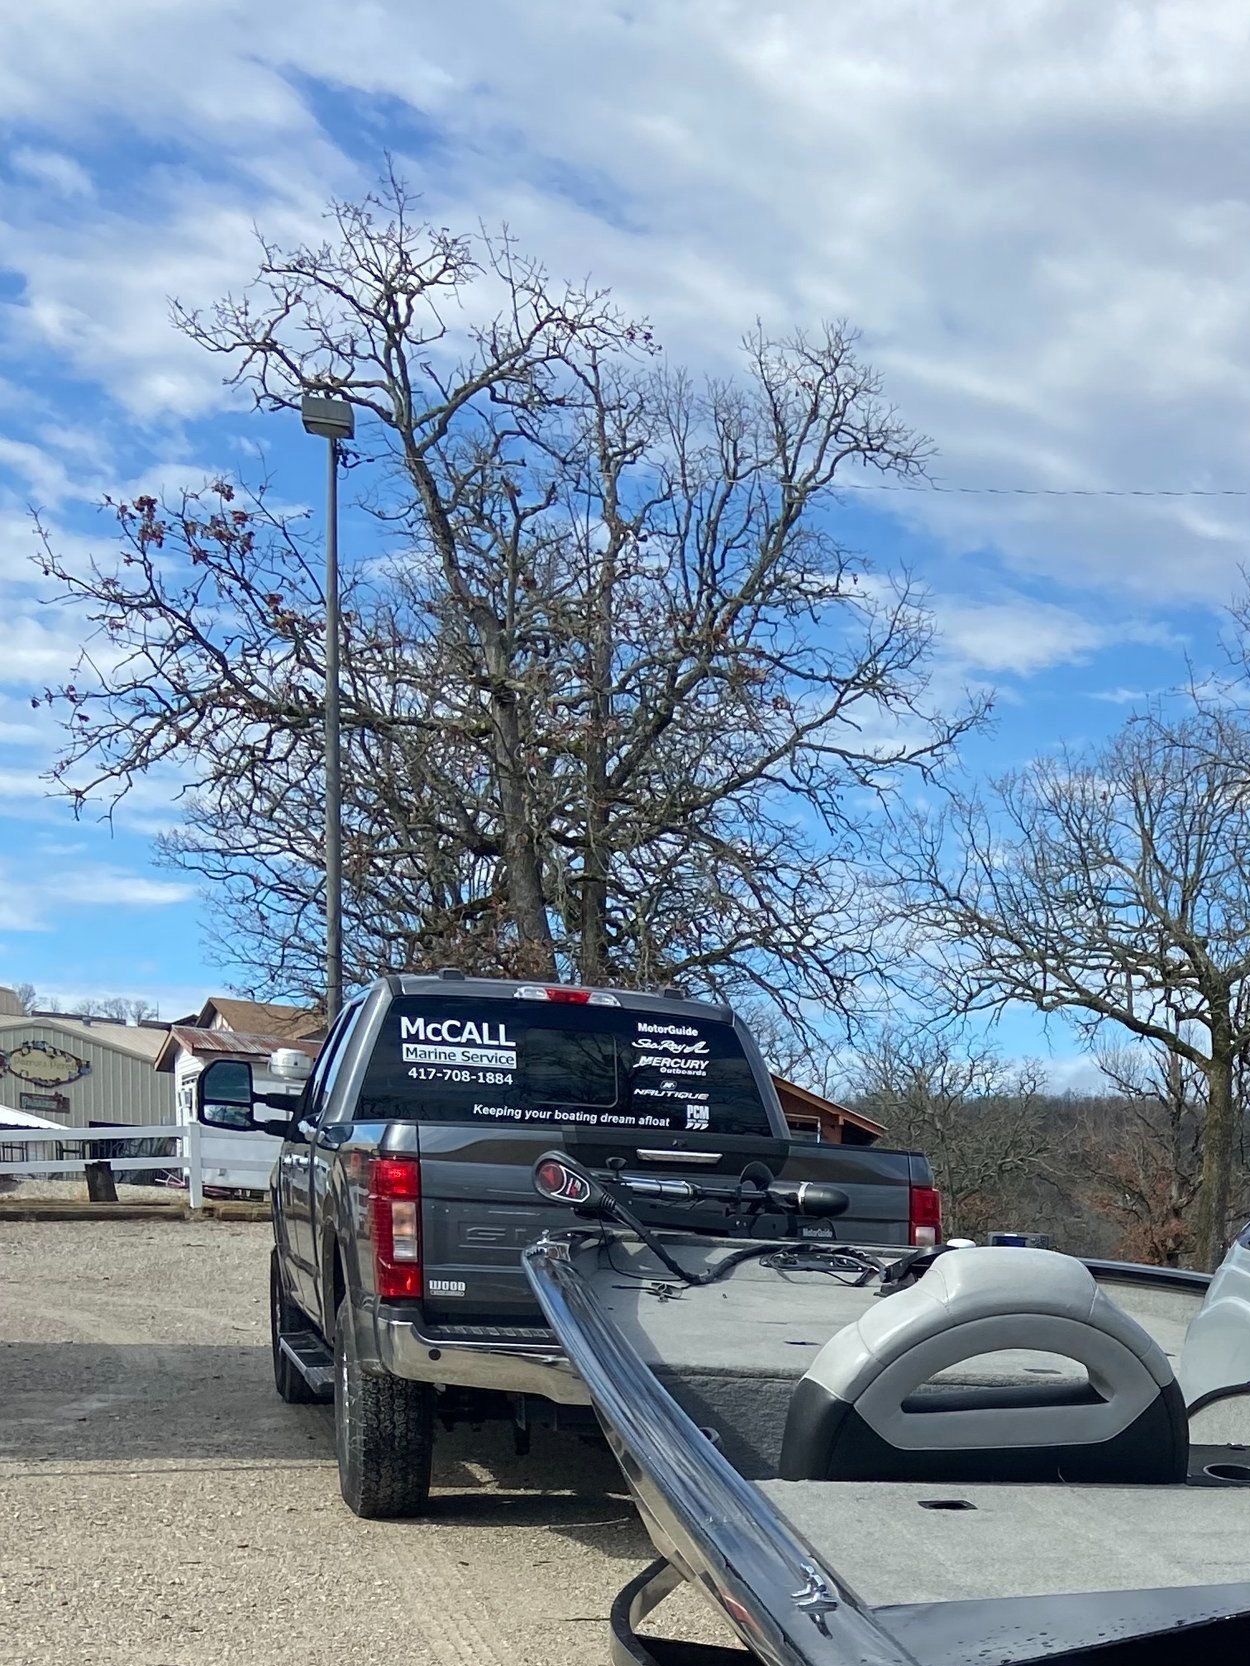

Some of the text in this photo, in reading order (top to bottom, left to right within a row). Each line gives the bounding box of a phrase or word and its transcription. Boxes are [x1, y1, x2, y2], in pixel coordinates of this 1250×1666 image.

[401, 1016, 516, 1047] McCALL
[637, 1022, 699, 1036] MotorGuide
[405, 1046, 515, 1066] Marine Service
[633, 1056, 709, 1070] MERCURY
[408, 1067, 514, 1086] 417-708-1884
[660, 1067, 707, 1077] Outboards
[634, 1089, 710, 1101] NAUTIQUE
[473, 1104, 670, 1127] Keeping your boating dream afloat
[686, 1104, 710, 1121] PCM
